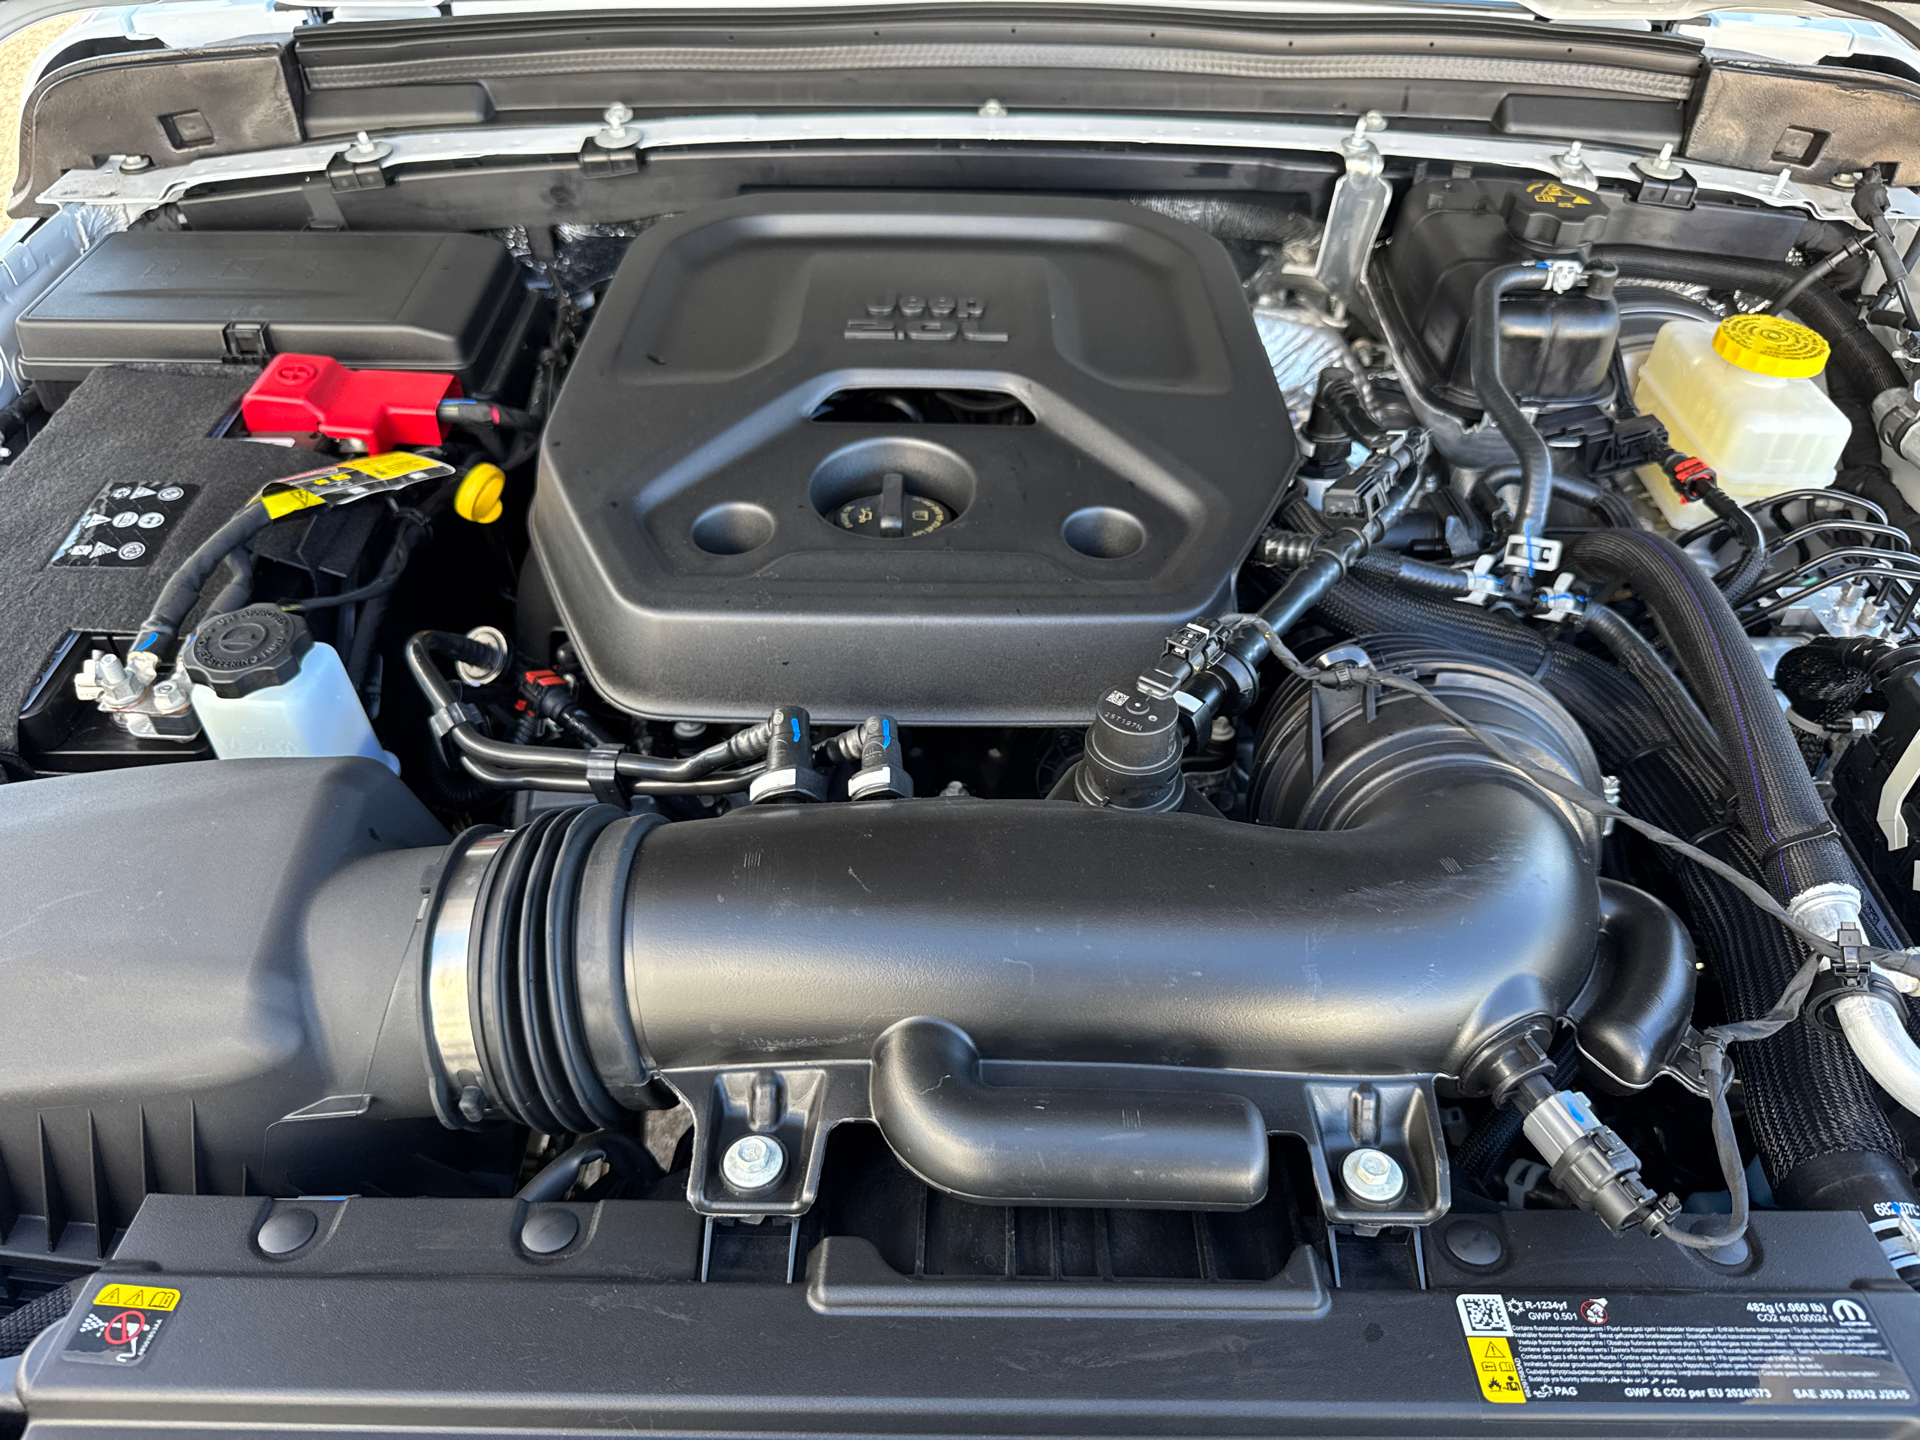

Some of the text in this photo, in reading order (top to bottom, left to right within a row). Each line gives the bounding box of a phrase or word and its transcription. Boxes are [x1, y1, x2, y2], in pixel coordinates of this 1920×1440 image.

[844, 319, 1009, 342] 2.0L
[241, 609, 287, 626] APPROVED
[210, 655, 258, 668] STEERING
[1524, 1301, 1568, 1311] R-1234yf
[1528, 1312, 1578, 1320] GWP 0.501
[1756, 1314, 1779, 1322] CO2
[1554, 1386, 1578, 1396] PAG
[1624, 1388, 1650, 1397] GWP
[1652, 1388, 1662, 1397] &
[1662, 1388, 1687, 1398] CO2
[1688, 1389, 1706, 1400] per
[1706, 1388, 1724, 1398] EU
[1792, 1388, 1818, 1399] SAE
